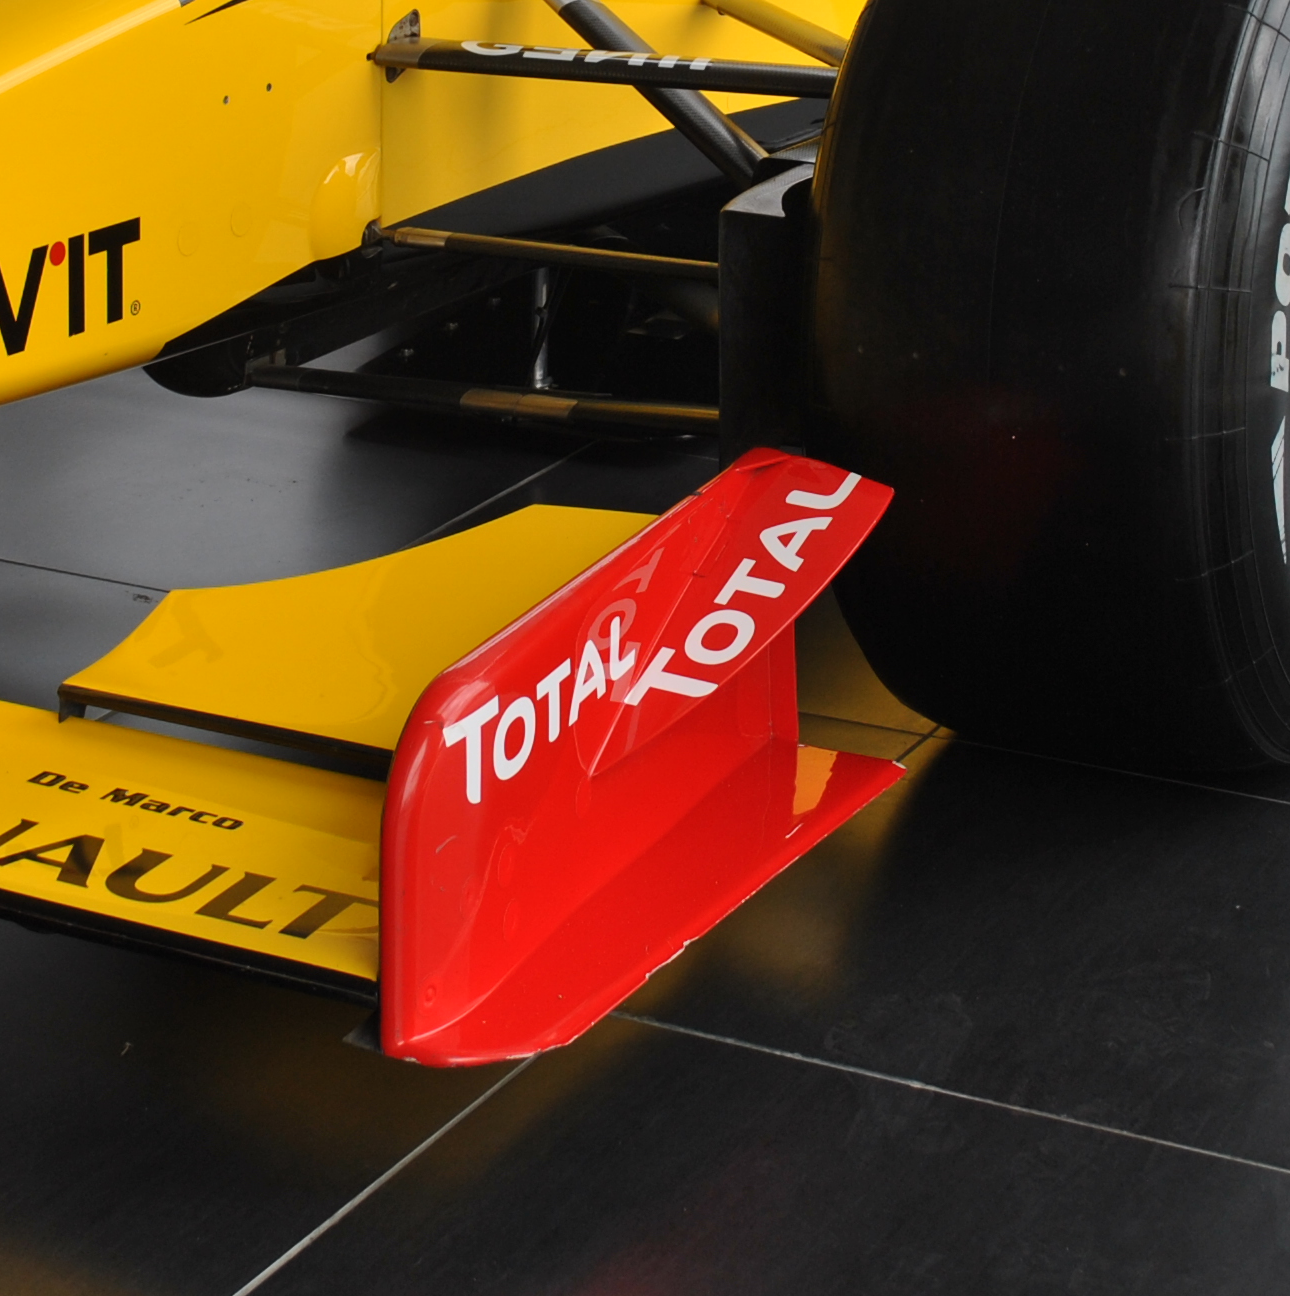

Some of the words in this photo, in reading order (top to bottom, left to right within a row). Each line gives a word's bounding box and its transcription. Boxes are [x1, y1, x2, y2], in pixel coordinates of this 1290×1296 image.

[623, 472, 862, 707] TOTAL
[27, 769, 89, 794] De
[100, 786, 244, 831] Marco
